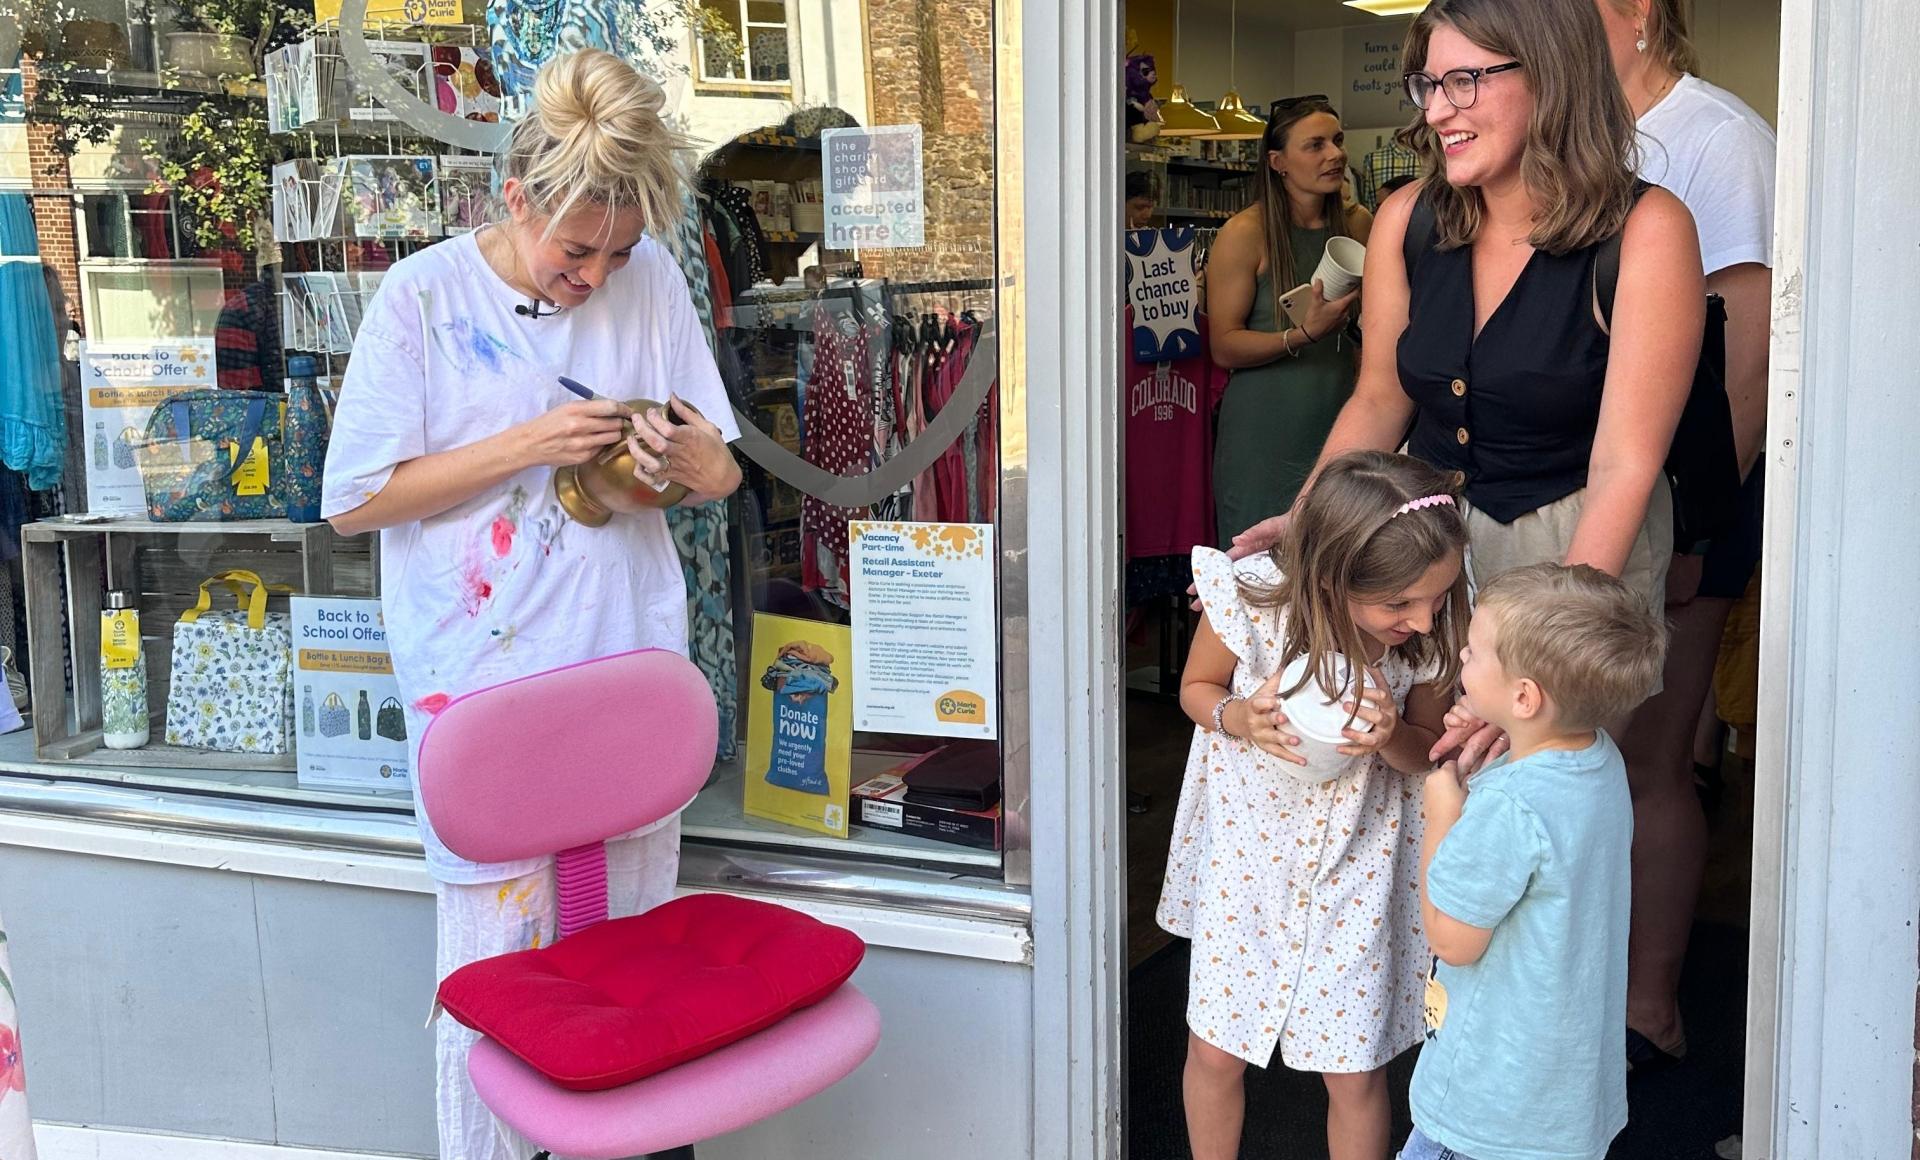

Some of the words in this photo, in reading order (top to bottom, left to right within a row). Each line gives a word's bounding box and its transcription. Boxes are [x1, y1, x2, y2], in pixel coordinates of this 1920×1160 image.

[428, 8, 455, 18] Curie
[1364, 42, 1388, 53] Turn
[1364, 58, 1395, 72] could
[835, 142, 856, 152] the
[834, 152, 878, 163] charity
[834, 166, 866, 176] shop
[835, 175, 856, 188] gift
[831, 200, 916, 219] accepted
[832, 223, 890, 242] here
[1141, 257, 1176, 279] Last
[1135, 278, 1190, 302] chance
[1142, 304, 1159, 321] to
[1160, 299, 1189, 319] buy
[155, 349, 169, 360] to
[94, 364, 147, 377] School
[152, 363, 188, 376] Offer
[1131, 377, 1197, 417] COLORADO
[861, 533, 900, 544] Vacancy
[861, 544, 904, 552] Part-time
[862, 557, 889, 566] Retail
[891, 558, 935, 568] Assistant
[862, 567, 905, 578] Manager
[912, 569, 943, 578] Exeter
[318, 609, 352, 622] Back
[356, 610, 370, 623] to
[303, 625, 348, 639] School
[352, 627, 386, 641] Offer
[306, 652, 329, 660] Bottle
[340, 654, 364, 662] Lunch
[367, 656, 383, 665] Bag
[957, 701, 976, 709] Marie
[780, 704, 819, 724] Donate
[779, 718, 816, 740] now
[779, 739, 788, 747] We
[788, 741, 812, 753] urgently
[778, 748, 792, 757] need
[792, 752, 805, 760] your
[777, 756, 805, 769] pre-loved
